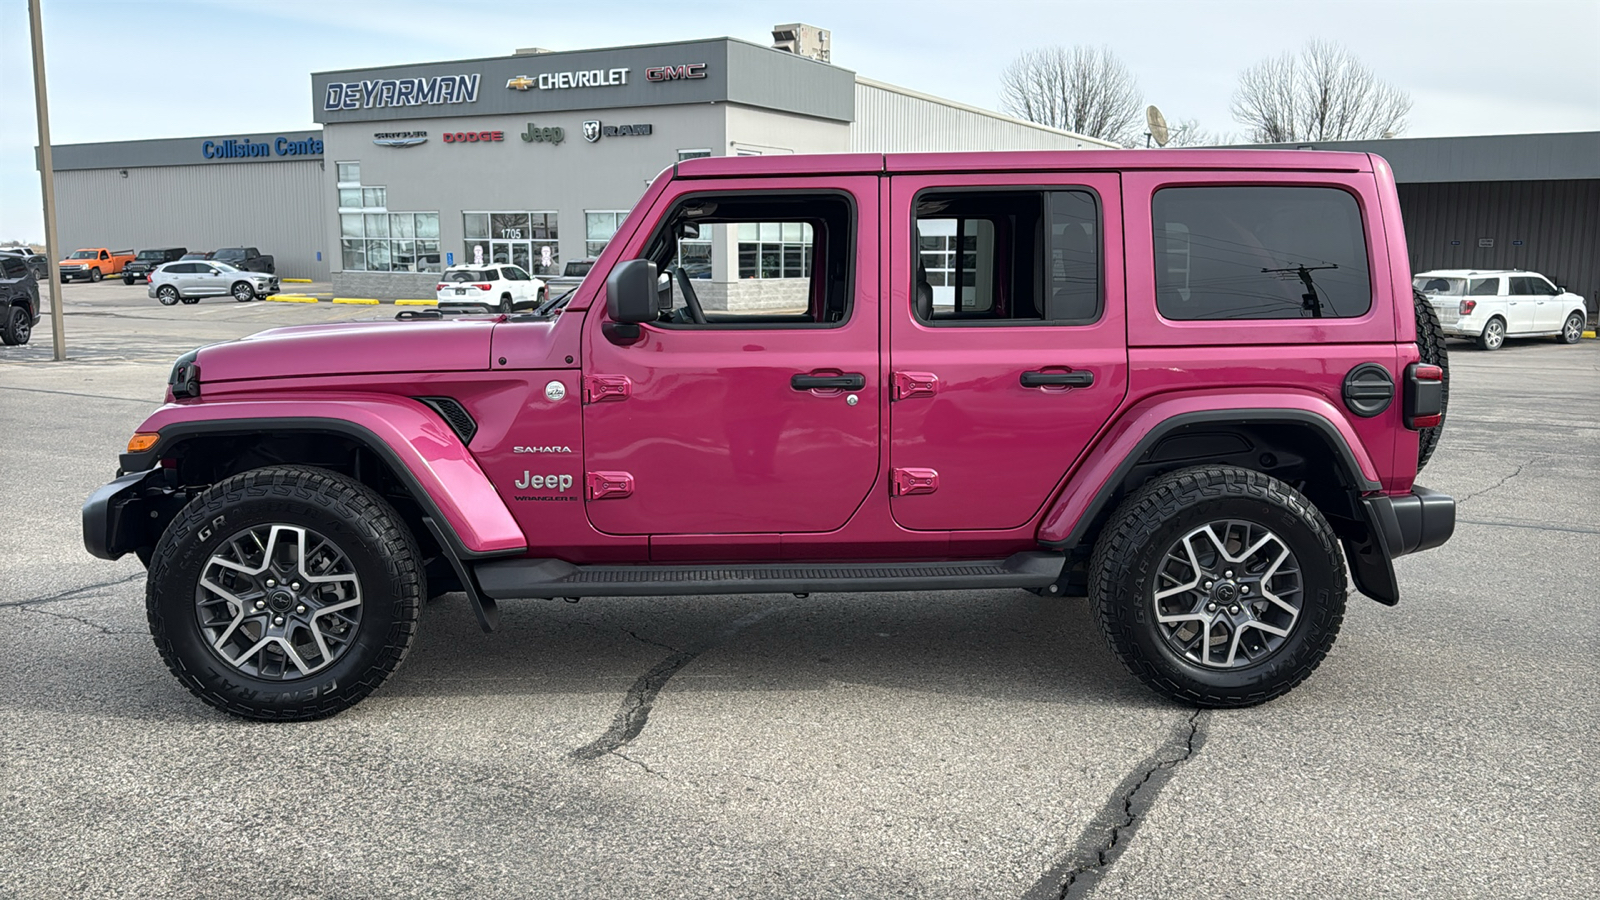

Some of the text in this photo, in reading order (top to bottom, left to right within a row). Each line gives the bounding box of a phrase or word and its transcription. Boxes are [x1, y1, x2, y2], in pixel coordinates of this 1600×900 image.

[538, 68, 628, 89] CHEVROLET
[645, 63, 706, 82] GMC
[324, 74, 480, 111] DEYARMAN
[443, 131, 504, 143] DODGE
[521, 122, 565, 146] Jeep
[603, 124, 652, 137] RAM
[202, 136, 323, 159] Collision Cente
[501, 228, 521, 239] 1705
[515, 470, 573, 492] Jeep
